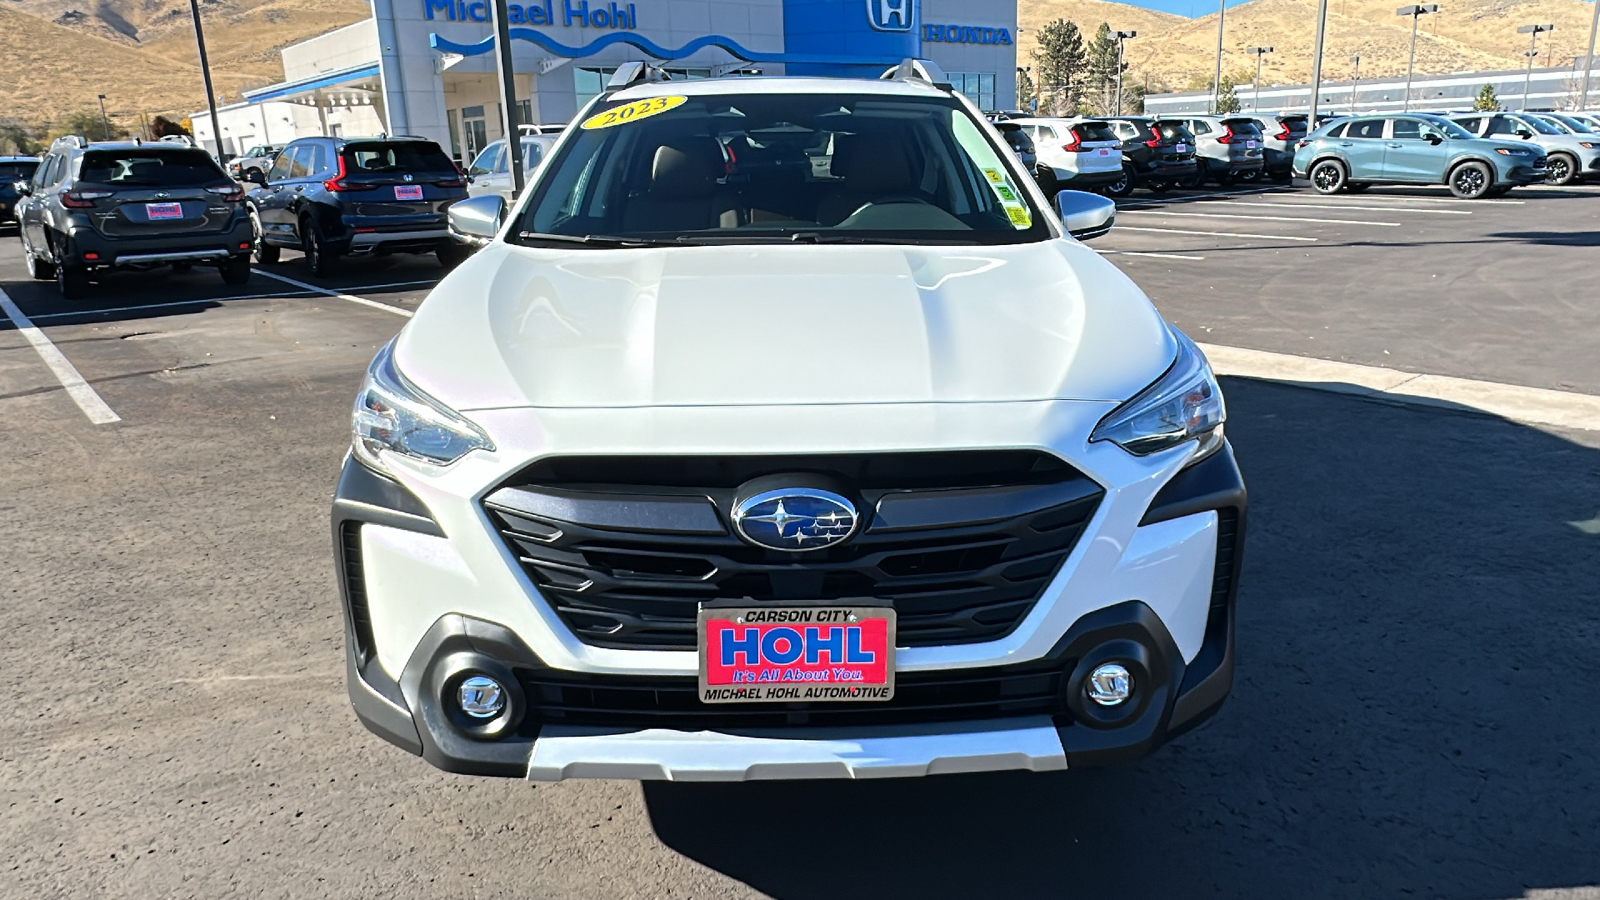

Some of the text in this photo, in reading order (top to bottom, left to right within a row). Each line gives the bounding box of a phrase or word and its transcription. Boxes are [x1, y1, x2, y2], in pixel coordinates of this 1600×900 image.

[424, 0, 637, 29] Micael Hohl
[922, 23, 1014, 46] HONDA
[602, 97, 668, 126] 2023
[745, 610, 852, 623] CARSON CITY
[720, 627, 875, 666] HOHL
[733, 670, 755, 682] It's
[758, 670, 780, 681] All
[783, 669, 829, 681] About
[704, 687, 890, 700] MICHAEL HOHL AUTOMOTIVE
